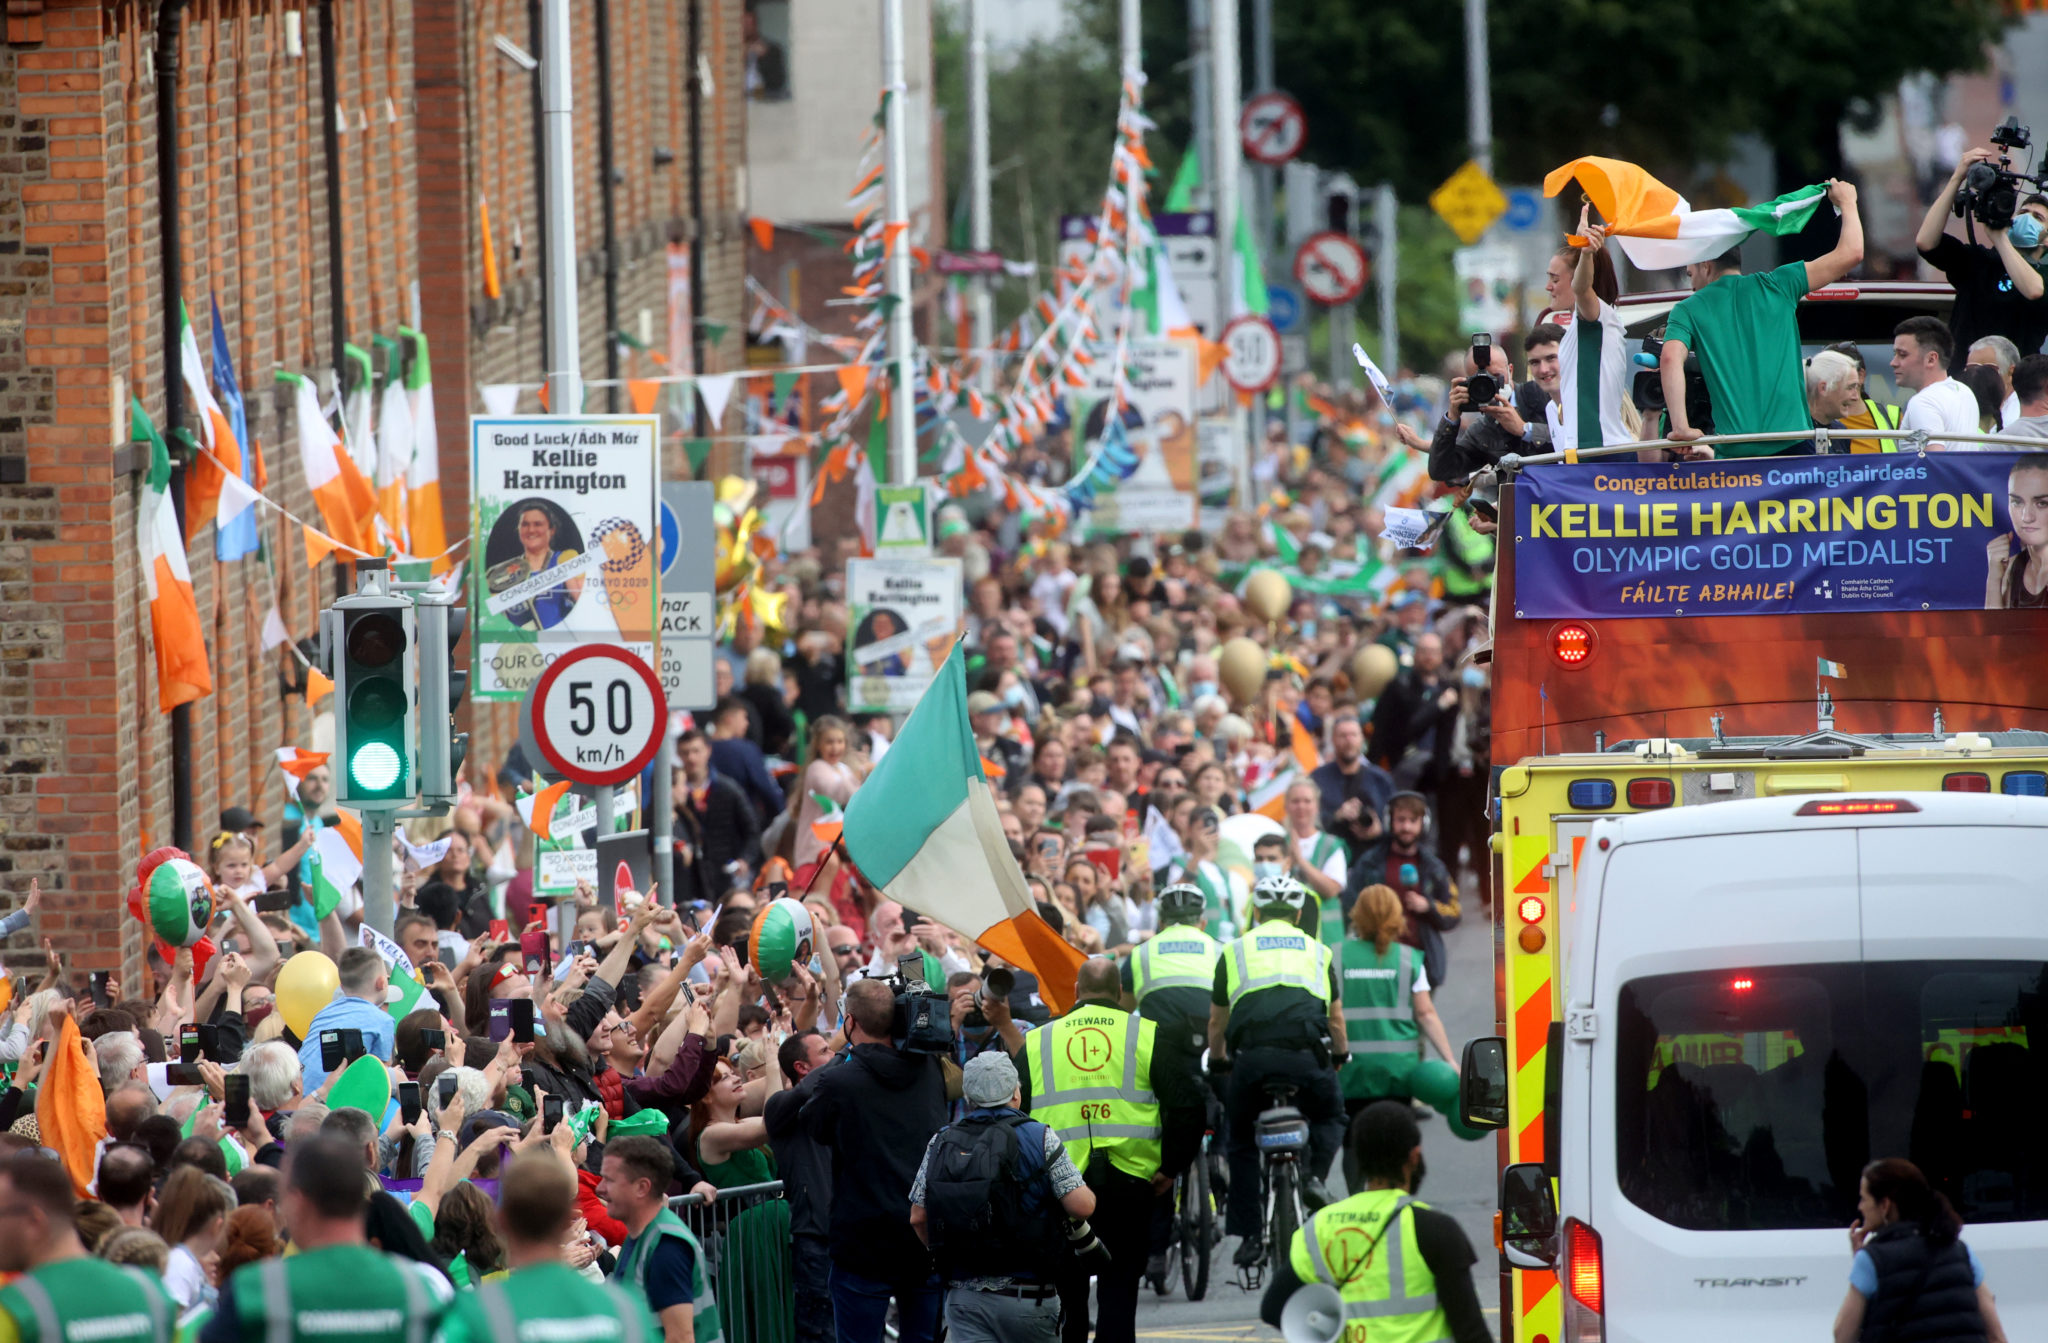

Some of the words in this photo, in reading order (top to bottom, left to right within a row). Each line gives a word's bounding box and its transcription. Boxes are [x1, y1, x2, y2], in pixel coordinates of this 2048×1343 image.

[494, 433, 529, 446] Good
[532, 450, 598, 467] Kellie
[503, 470, 626, 495] Harrington
[1594, 472, 1762, 495] Congratulations
[1767, 464, 1928, 488] Comhghairdeas
[1530, 503, 1679, 538] KELLIE
[1691, 493, 1994, 536] HARRINGTON
[1573, 545, 1701, 573] OLYMPIC
[1710, 543, 1793, 570] GOLD
[1802, 538, 1953, 568] MEDALIST
[500, 553, 592, 602] CONGRATULATIONS
[586, 578, 620, 587] TOKYO
[622, 577, 649, 588] 2020
[1620, 581, 1691, 604] FÁILTE
[1699, 581, 1795, 602] ABHAILE!
[660, 598, 690, 612] har
[660, 615, 701, 631] ACK
[569, 679, 632, 736] 50
[576, 743, 625, 765] km/h
[1158, 942, 1205, 954] GARDA
[1257, 936, 1305, 950] GARDA
[1344, 969, 1397, 980] COMMUNITY
[1065, 1016, 1115, 1028] STEWARD
[1080, 1103, 1111, 1120] 676
[1262, 1133, 1302, 1145] GARDA
[1694, 1275, 1808, 1289] TRANSIT
